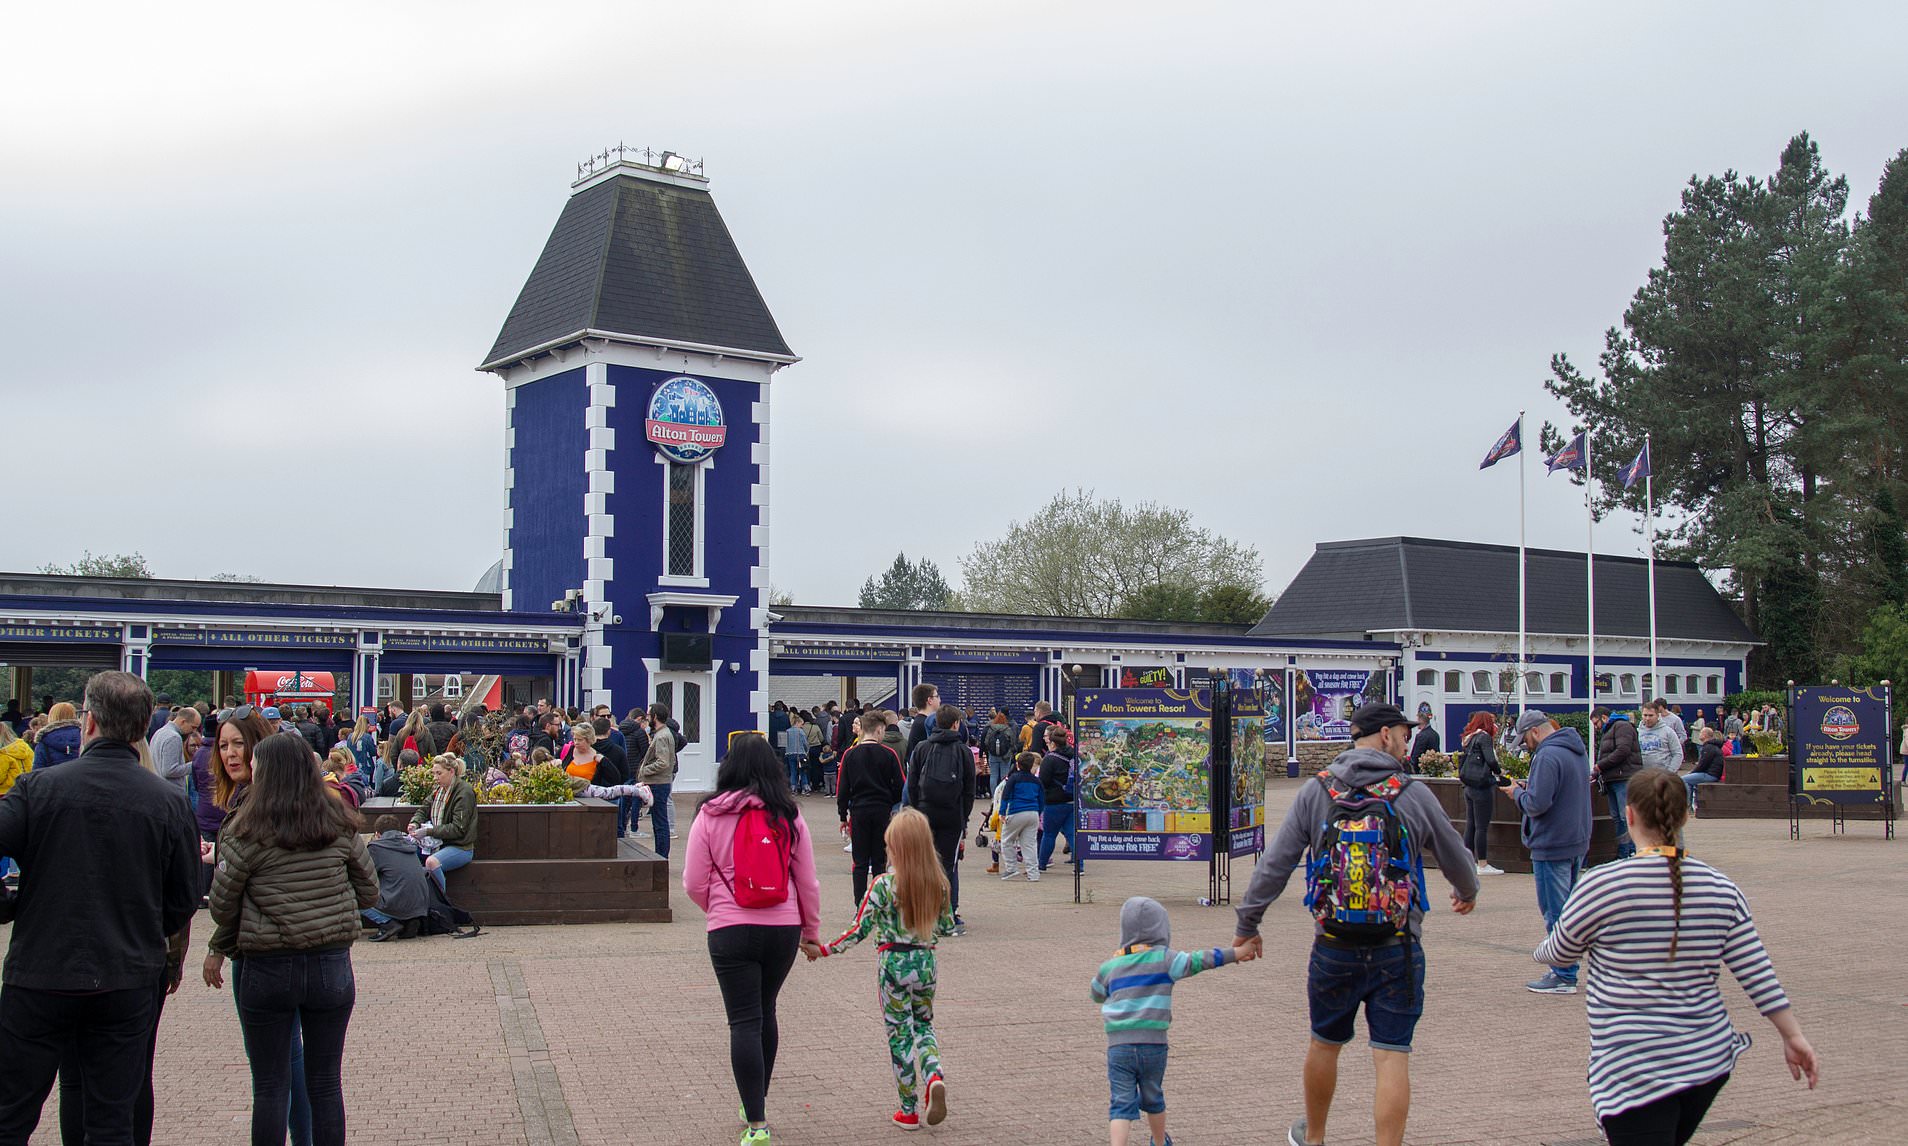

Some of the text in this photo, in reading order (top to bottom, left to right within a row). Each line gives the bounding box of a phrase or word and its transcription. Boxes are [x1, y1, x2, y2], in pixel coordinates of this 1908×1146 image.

[651, 424, 722, 442] Alton Towers
[0, 628, 110, 638] OTHER TICKETS
[220, 633, 346, 644] ALL OTHER TICKETS
[439, 639, 458, 647] ALL
[499, 641, 540, 649] TICKETS
[1818, 695, 1852, 703] Welcome
[1101, 703, 1186, 713] Alton Towers Resort
[1810, 750, 1834, 758] already,
[1835, 750, 1855, 758] please
[1806, 757, 1829, 765] straight
[1088, 834, 1097, 843] Pay
[1112, 835, 1122, 843] day
[1090, 842, 1099, 851] all
[1349, 821, 1364, 910] EASTP
